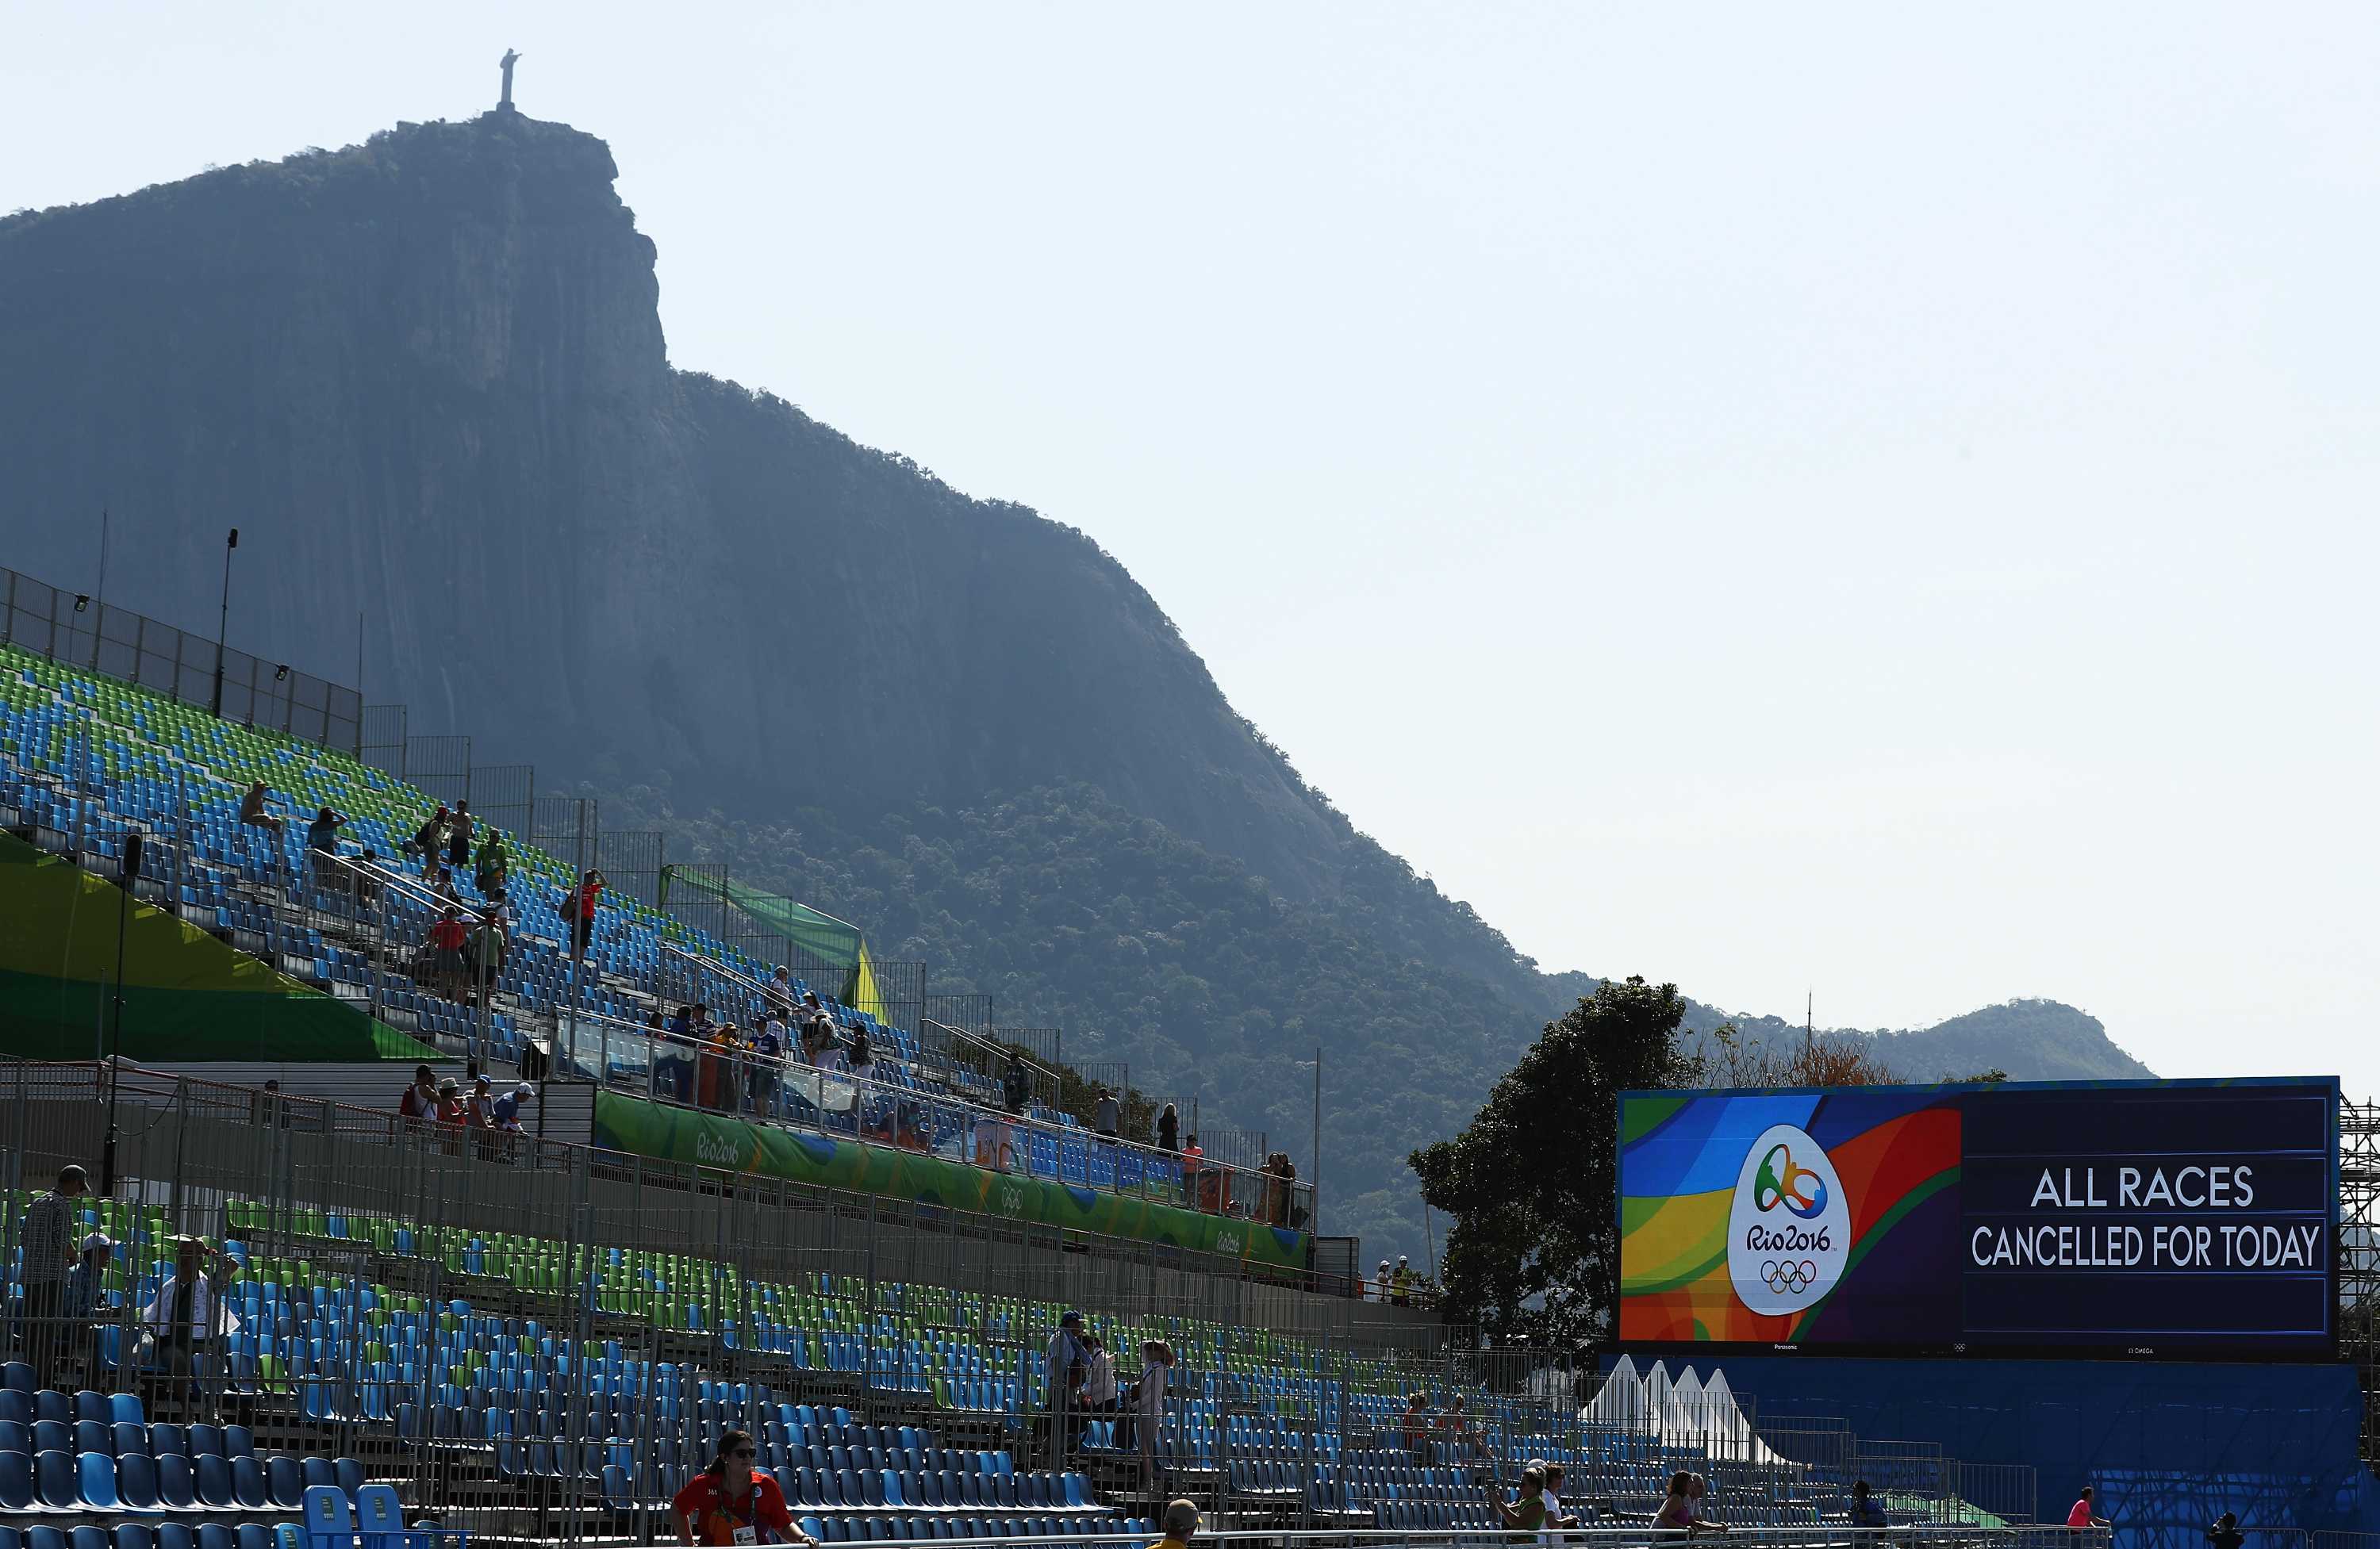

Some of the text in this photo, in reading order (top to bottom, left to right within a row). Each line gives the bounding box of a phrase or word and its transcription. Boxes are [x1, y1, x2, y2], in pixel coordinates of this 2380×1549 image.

[2031, 1166, 2253, 1206] ALL RACES
[1747, 1225, 1830, 1252] Rio2016
[1972, 1225, 2320, 1266] CANCELLED FOR TODAY
